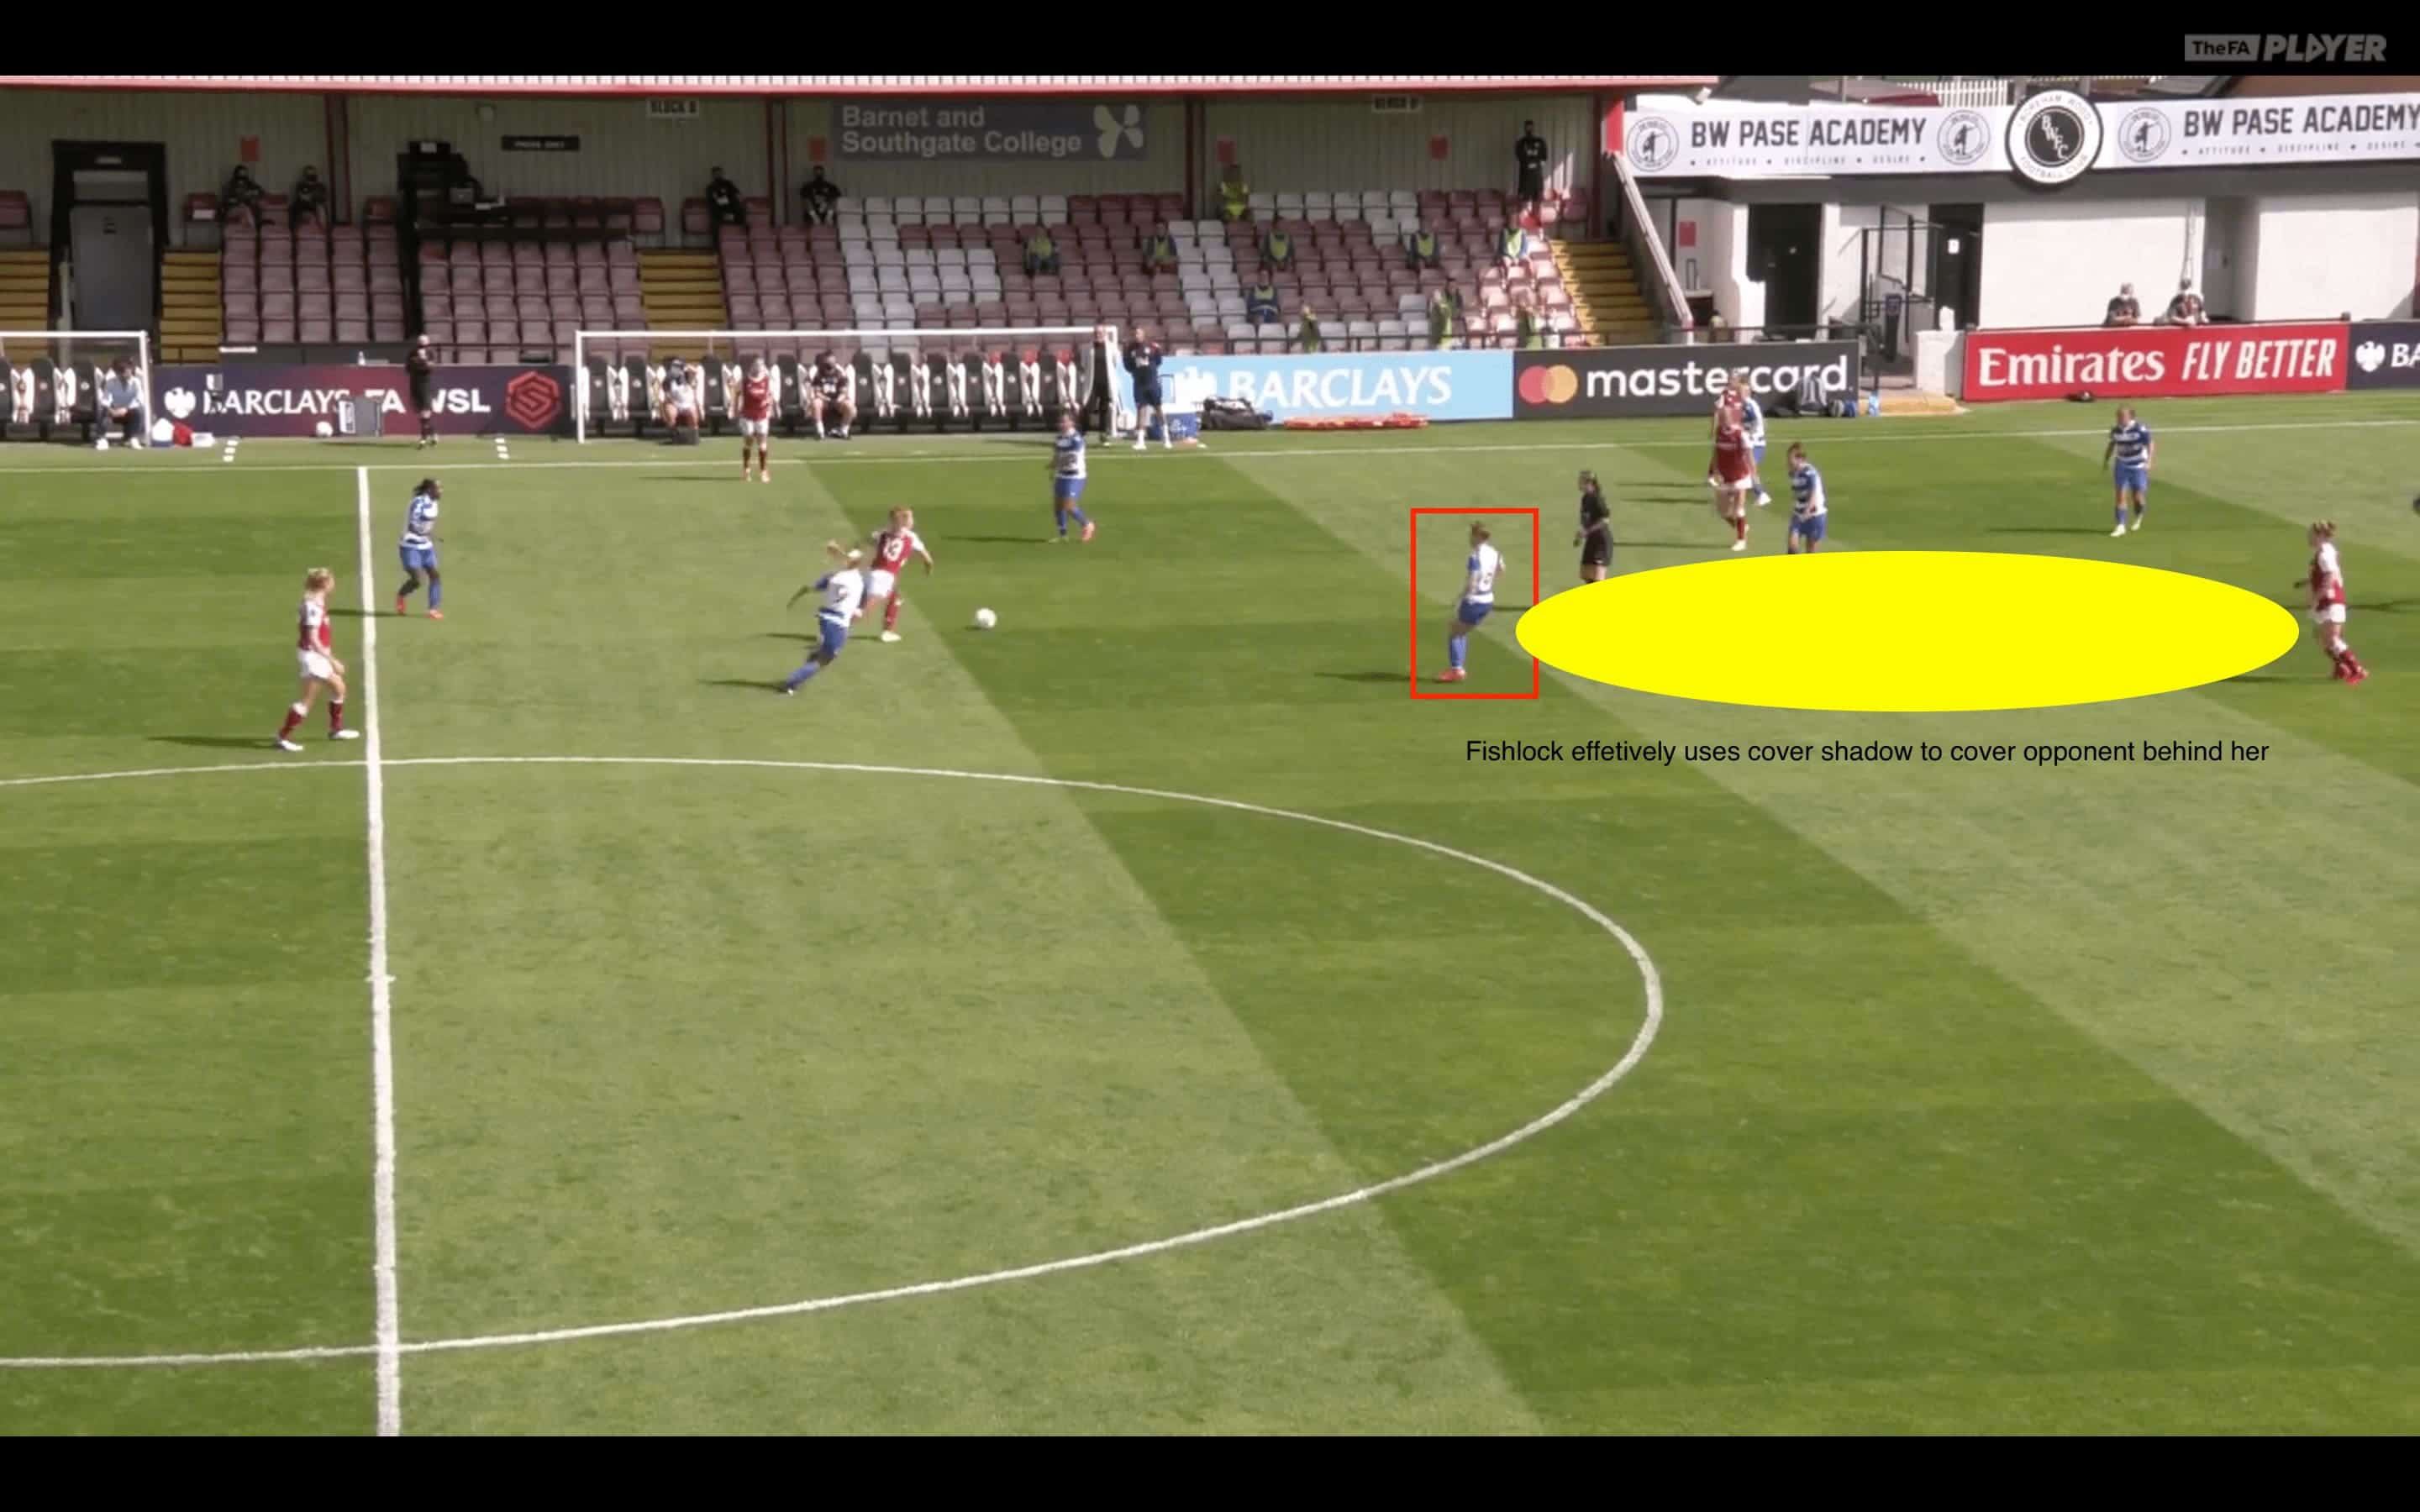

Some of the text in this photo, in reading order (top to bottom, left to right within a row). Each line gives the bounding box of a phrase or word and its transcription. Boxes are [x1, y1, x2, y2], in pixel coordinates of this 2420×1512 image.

[843, 106, 984, 127] Barnet and
[2184, 109, 2223, 137] BW
[2233, 108, 2294, 135] PASE
[2302, 104, 2420, 133] ACADEMY
[842, 130, 1081, 157] Southgate College
[1691, 121, 1730, 148] BW
[1739, 120, 1800, 146] PASE
[1809, 118, 1927, 146] ACADEMY
[1784, 155, 1845, 165] DISCIPLINE
[2198, 145, 2251, 155] ATTITUDE
[2277, 142, 2339, 154] DISCIPLINE
[1979, 338, 2337, 386] Emirates FLY BETTER
[1228, 365, 1453, 409] BARCLAYS
